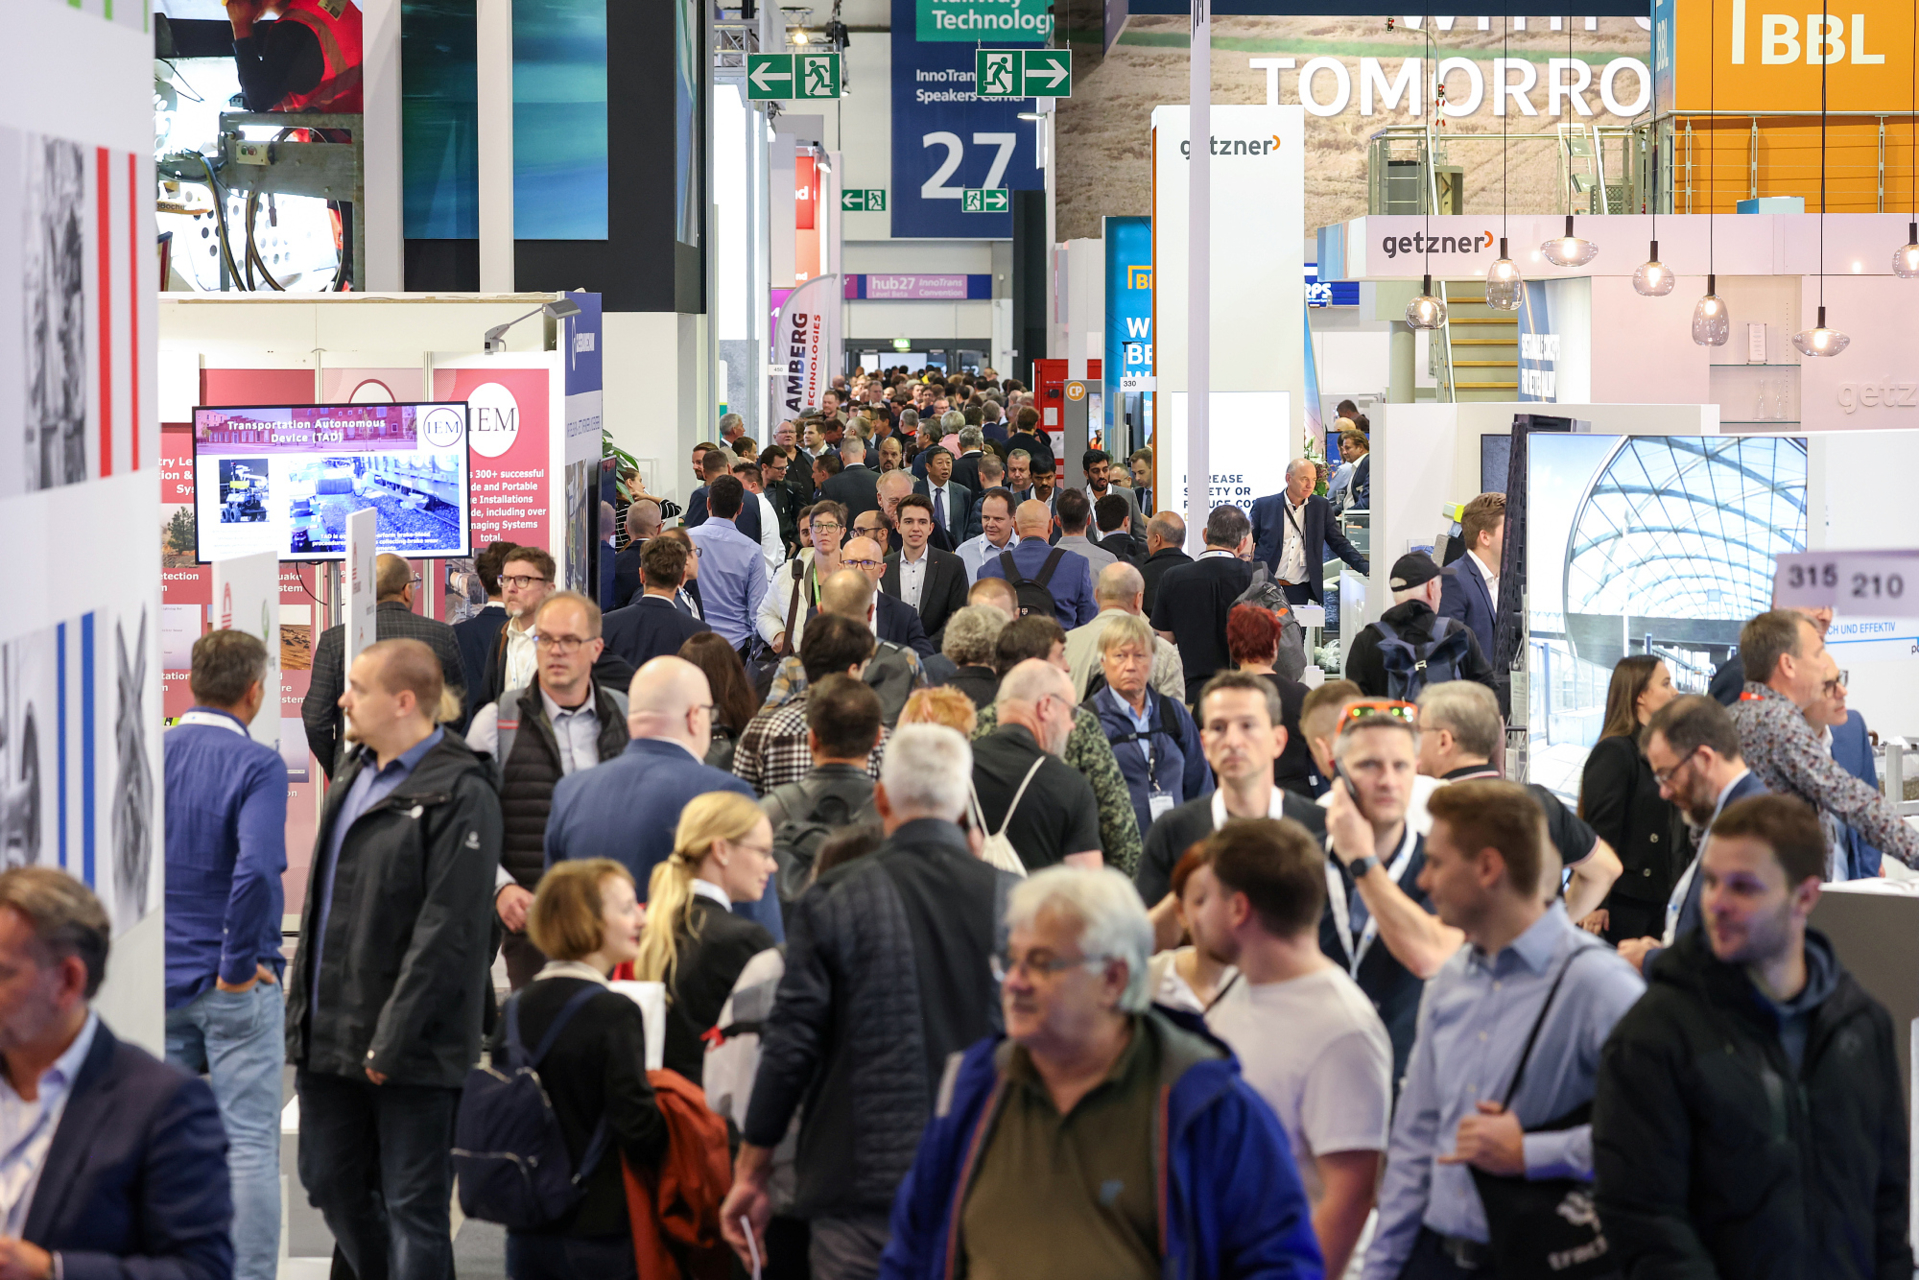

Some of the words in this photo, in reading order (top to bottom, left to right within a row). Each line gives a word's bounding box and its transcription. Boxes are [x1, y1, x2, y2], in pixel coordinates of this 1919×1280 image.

[1761, 13, 1886, 65] BBL
[916, 69, 976, 82] InnoTran
[1249, 56, 1651, 117] TOMORRO
[916, 88, 977, 105] Speakers
[1180, 134, 1274, 160] gtzner
[921, 131, 1017, 199] 27
[1382, 230, 1485, 259] getzner
[872, 276, 916, 290] hub27
[919, 278, 963, 287] InnoTrans
[919, 289, 964, 297] Convention
[786, 313, 808, 413] AMBERG
[807, 314, 822, 407] ECHNOLOGIES
[1068, 386, 1083, 397] CP
[227, 420, 311, 432] Transportation
[314, 419, 386, 429] Autonomous
[468, 407, 517, 432] IEM
[427, 421, 459, 435] IEM
[271, 434, 308, 443] Device
[312, 433, 343, 444] (TAD)
[475, 470, 498, 478] 300+
[500, 469, 544, 478] successful
[1183, 474, 1244, 484] IEASE
[484, 482, 500, 491] and
[502, 482, 538, 491] Portable
[1183, 486, 1231, 496] SETY
[1235, 486, 1251, 496] OR
[480, 495, 533, 504] Installations
[486, 507, 526, 518] including
[527, 508, 547, 516] over
[502, 520, 538, 531] Systems
[480, 532, 504, 542] total.
[1851, 572, 1904, 599] 210
[1840, 624, 1858, 634] UND
[1860, 622, 1896, 634] EFFEKTIV
